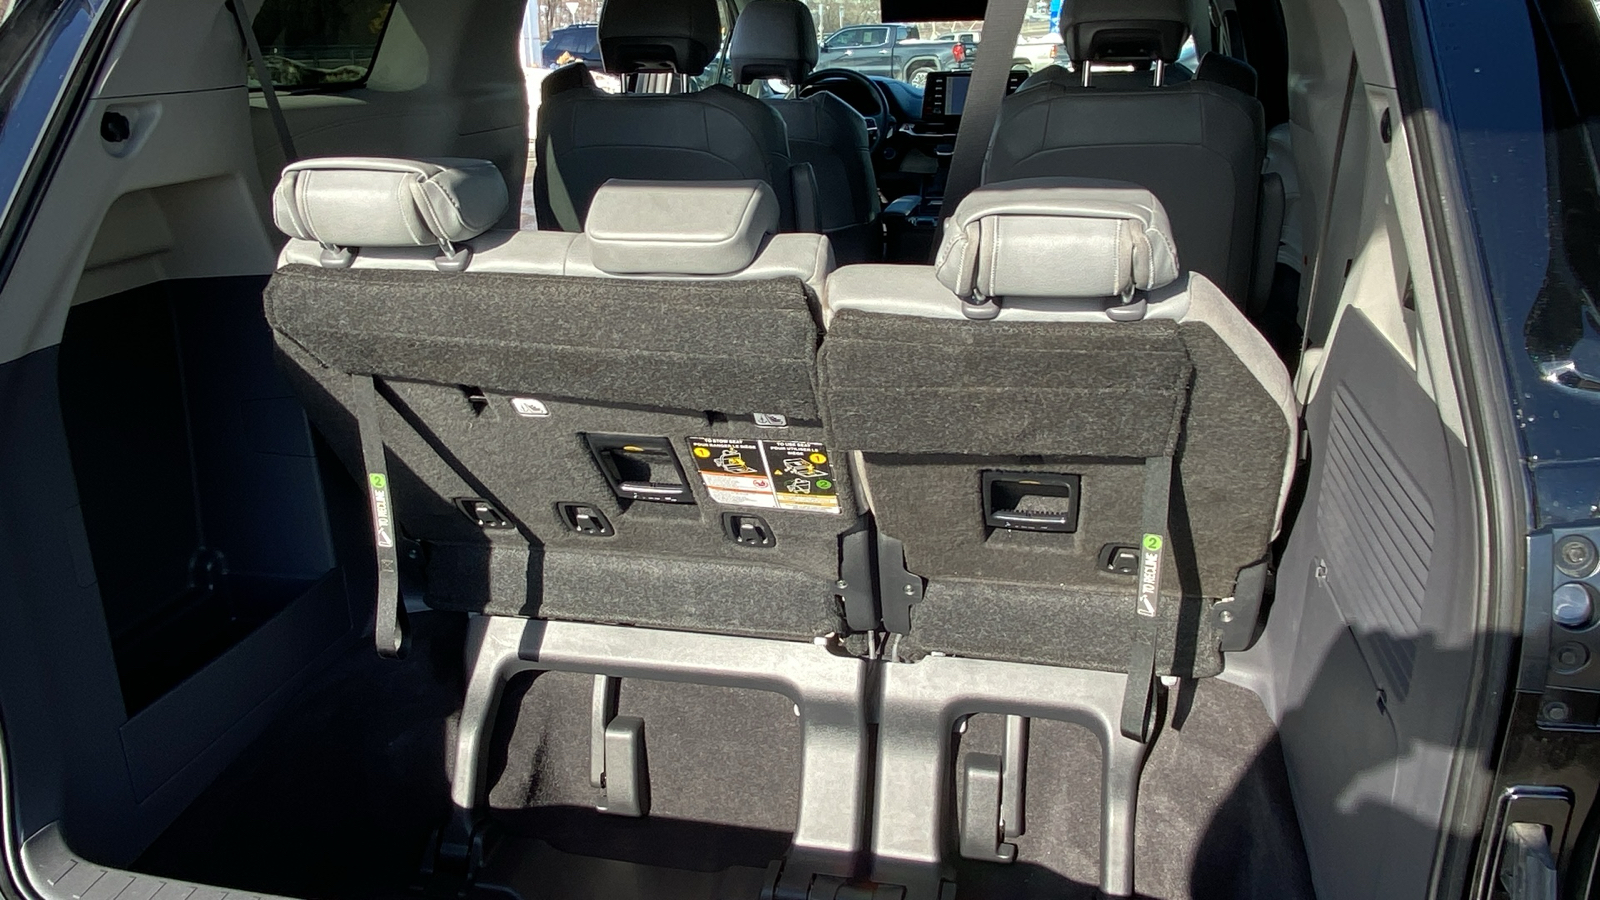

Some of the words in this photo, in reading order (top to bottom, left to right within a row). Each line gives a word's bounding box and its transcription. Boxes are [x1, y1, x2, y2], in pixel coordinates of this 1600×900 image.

[378, 517, 389, 527] TO
[1143, 552, 1158, 584] RECLINE
[1142, 584, 1155, 594] TO
